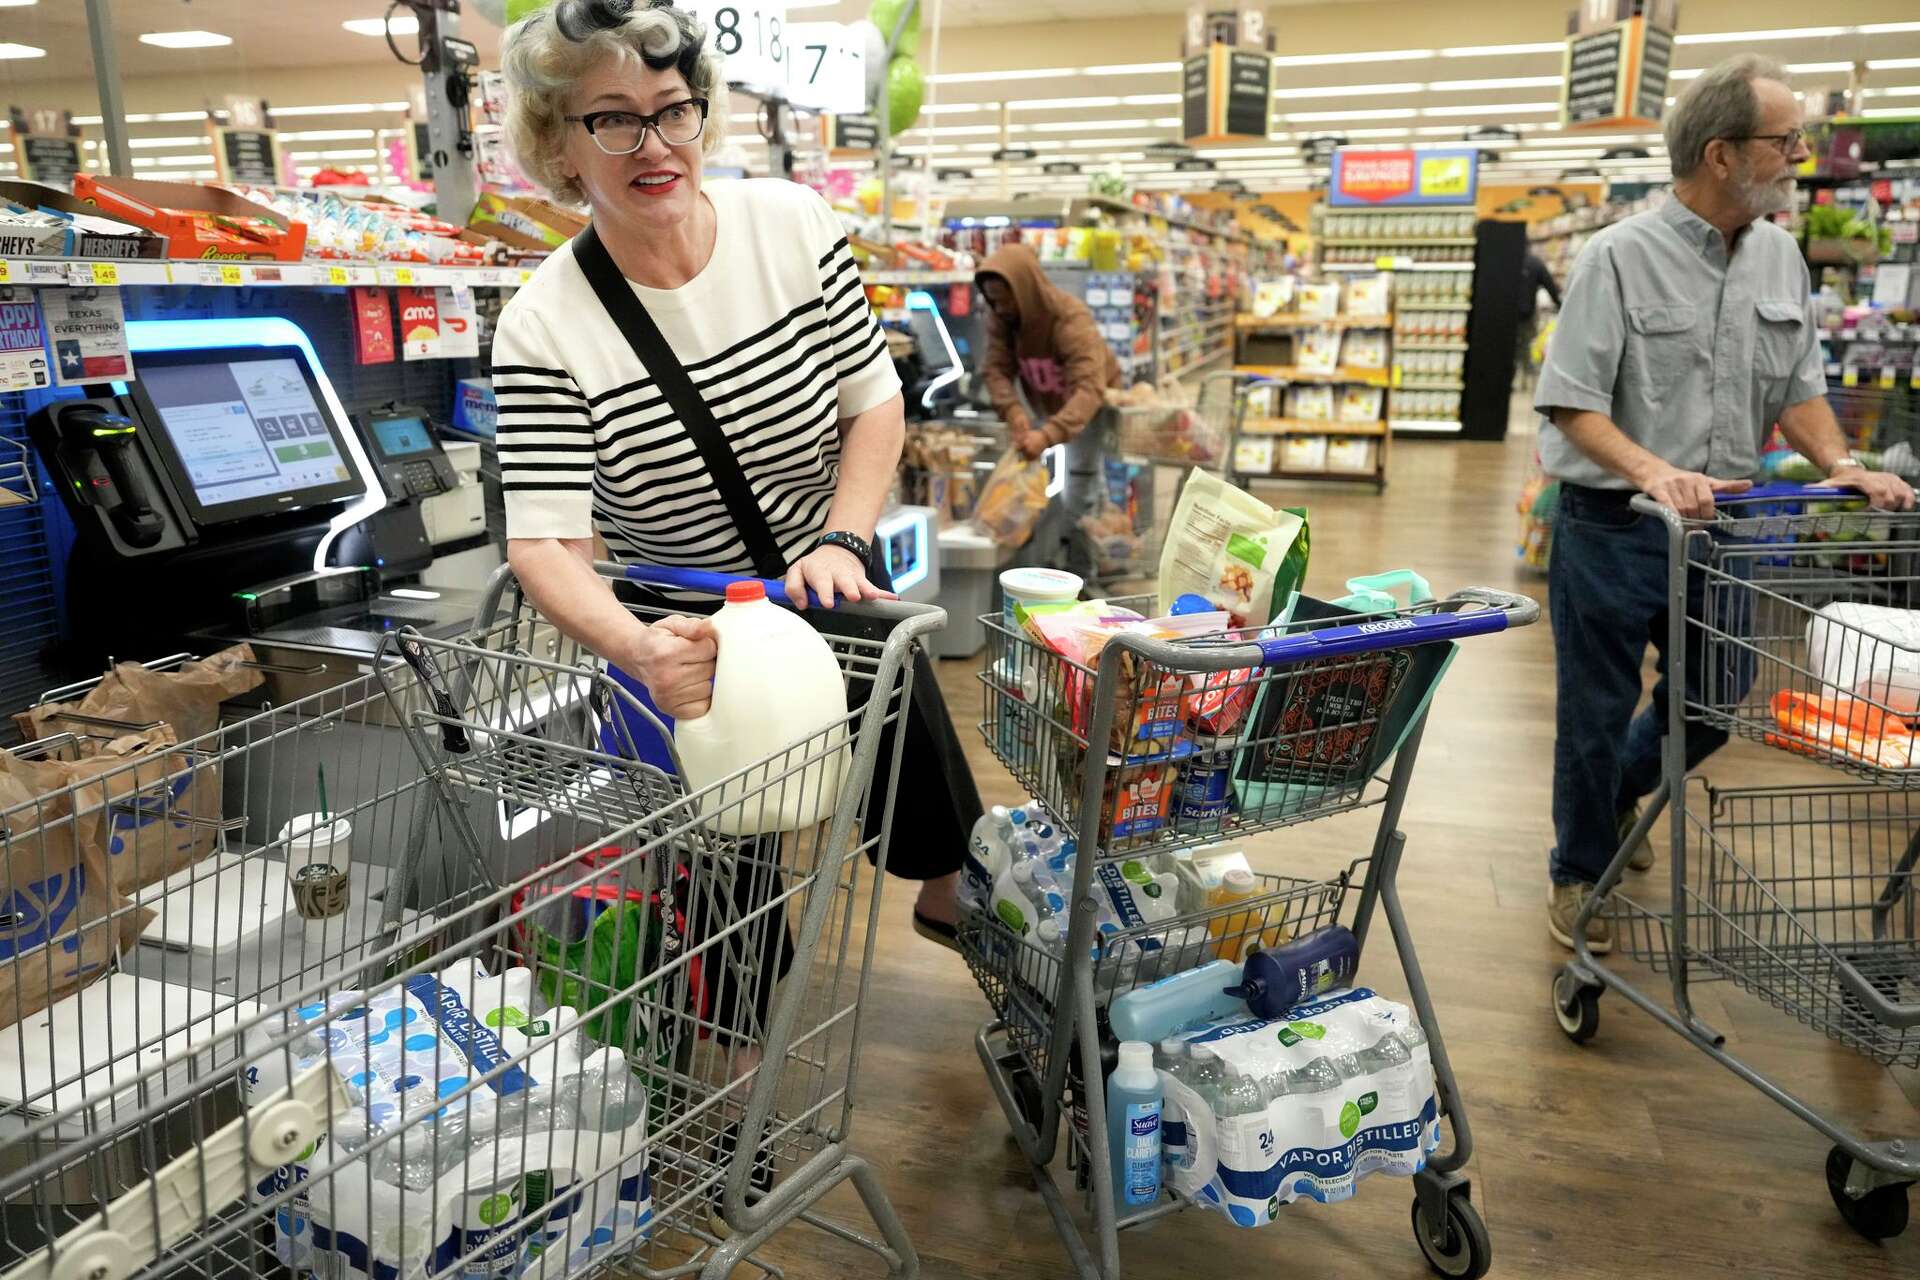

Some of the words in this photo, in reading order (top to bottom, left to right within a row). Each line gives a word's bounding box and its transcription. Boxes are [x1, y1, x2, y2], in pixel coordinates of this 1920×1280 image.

[0, 236, 35, 255] HEY'S
[83, 237, 140, 257] HERSHEY'S
[68, 309, 102, 319] TEXAS
[403, 305, 436, 321] amc
[54, 322, 120, 334] EVERYTHING
[1358, 618, 1418, 634] KROGER
[1147, 704, 1179, 721] BITES
[1122, 803, 1159, 820] BITES
[247, 1066, 259, 1085] 4
[1134, 1117, 1158, 1129] Suave
[1258, 1129, 1275, 1150] 24
[1280, 1150, 1343, 1169] VAPOR
[1346, 1121, 1420, 1159] DISTILLED
